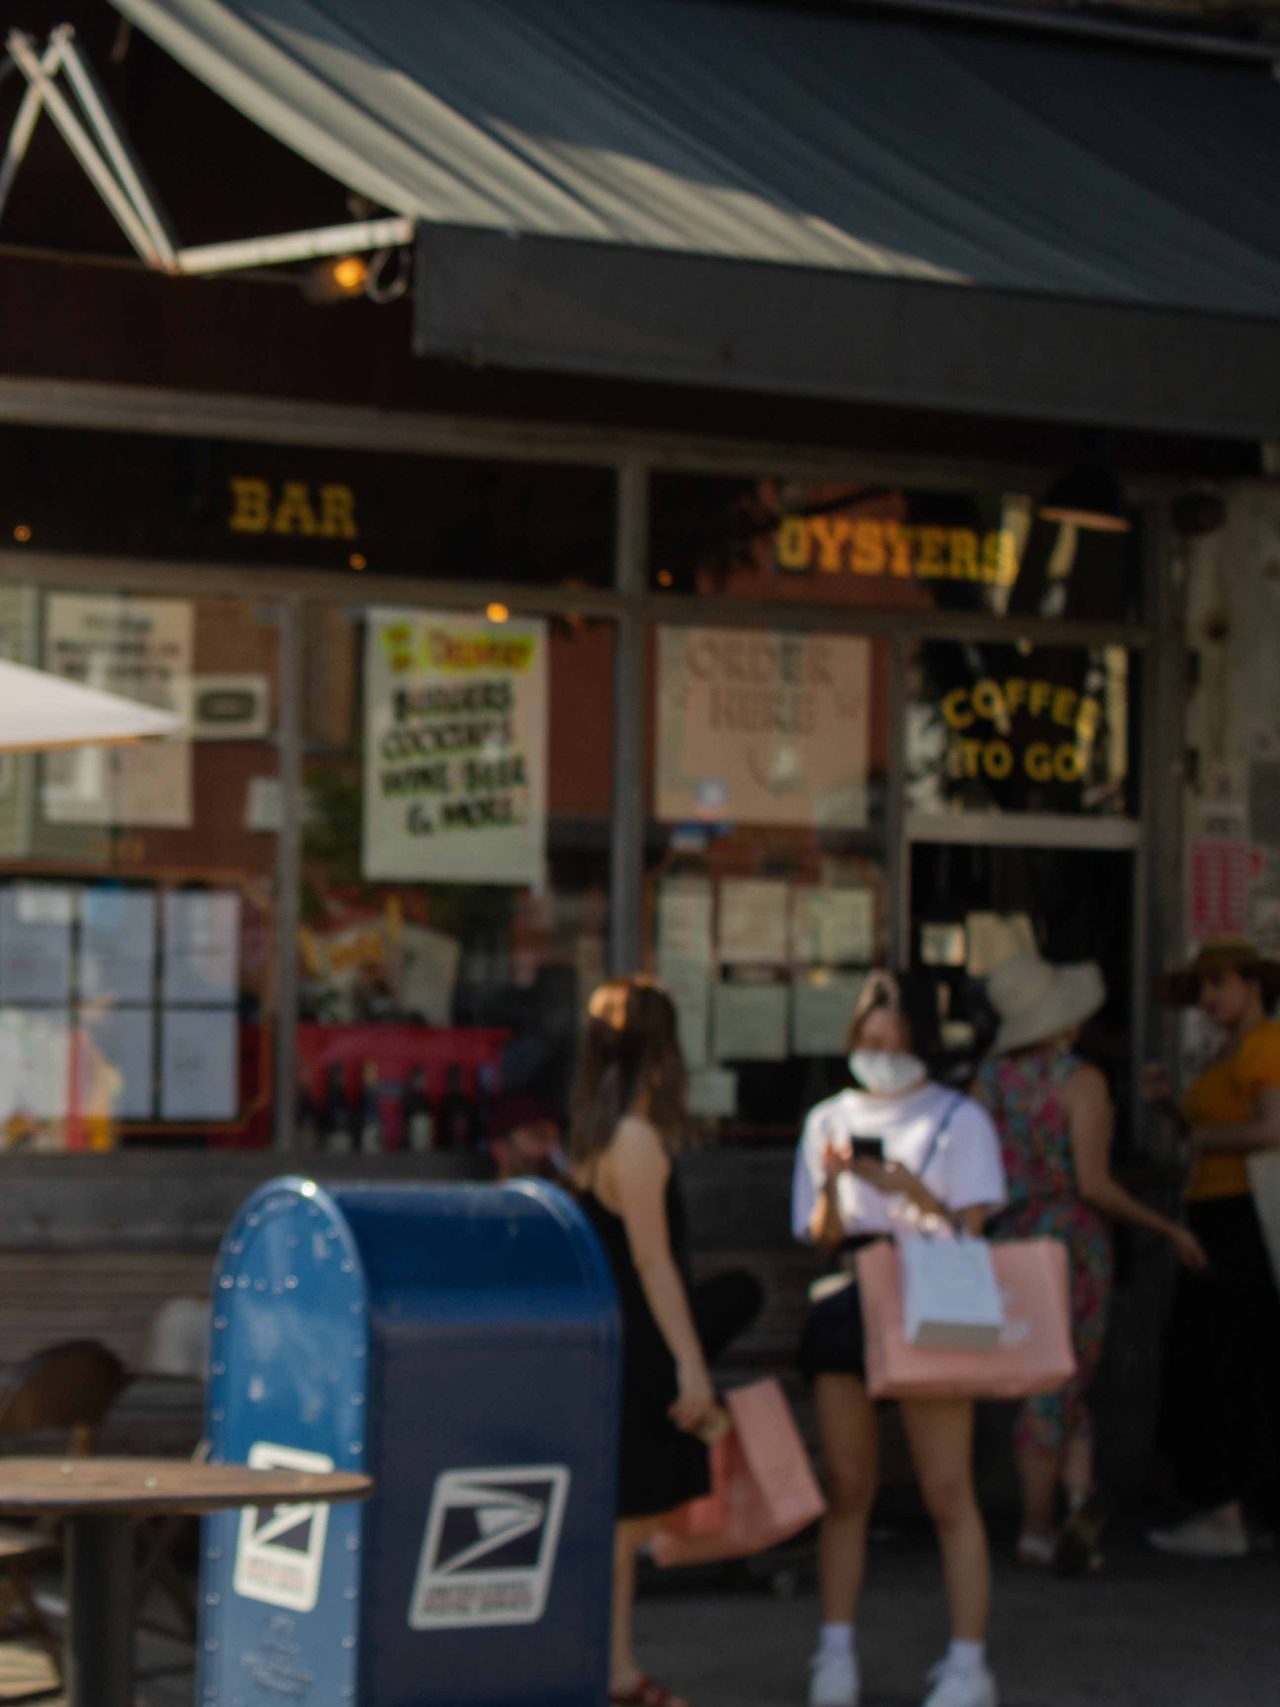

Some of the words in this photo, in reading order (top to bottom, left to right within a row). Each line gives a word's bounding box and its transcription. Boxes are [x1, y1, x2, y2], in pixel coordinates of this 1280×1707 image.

[229, 477, 358, 540] BAR
[777, 515, 1018, 586] OYSTERS
[957, 738, 1013, 782] TO
[1024, 742, 1081, 782] GO
